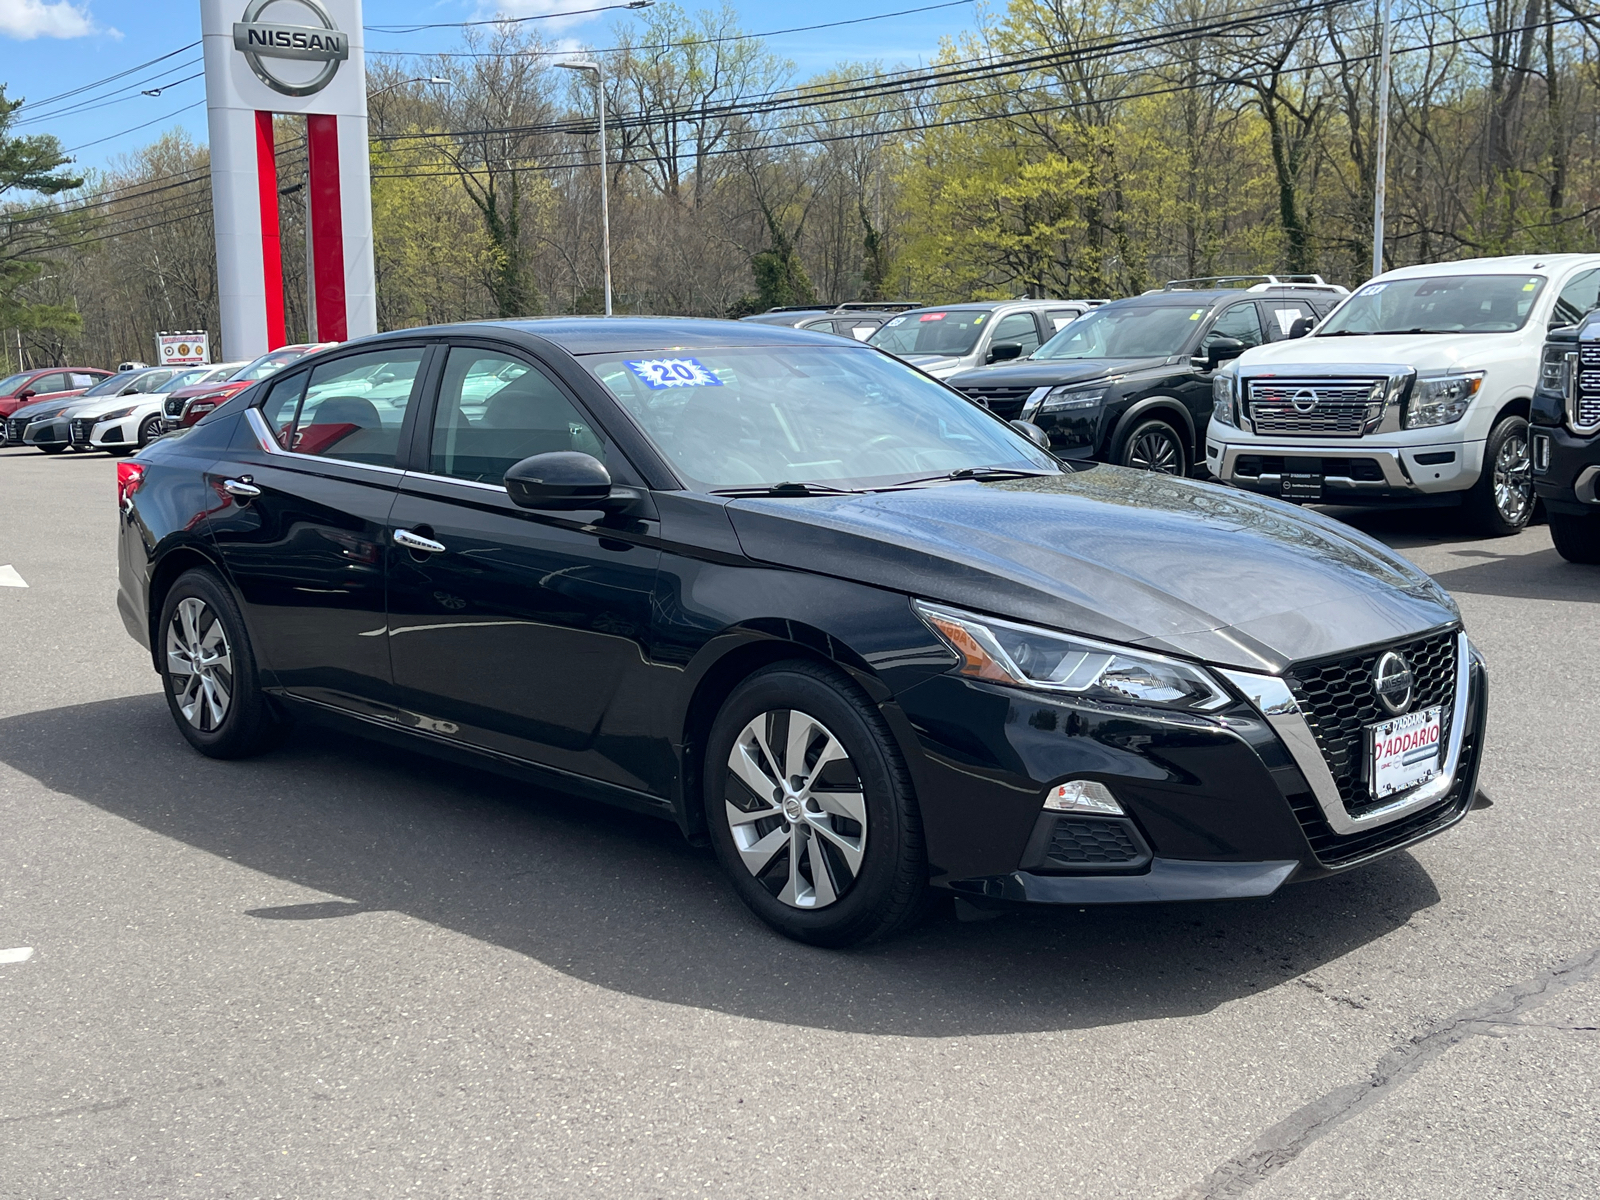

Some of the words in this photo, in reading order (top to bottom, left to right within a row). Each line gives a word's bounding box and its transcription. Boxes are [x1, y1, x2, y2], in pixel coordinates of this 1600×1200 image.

[248, 28, 341, 53] NISSAN
[651, 363, 695, 381] 20
[1393, 711, 1426, 731] D'ADDARIO
[1375, 724, 1439, 761] D'ADDARIO
